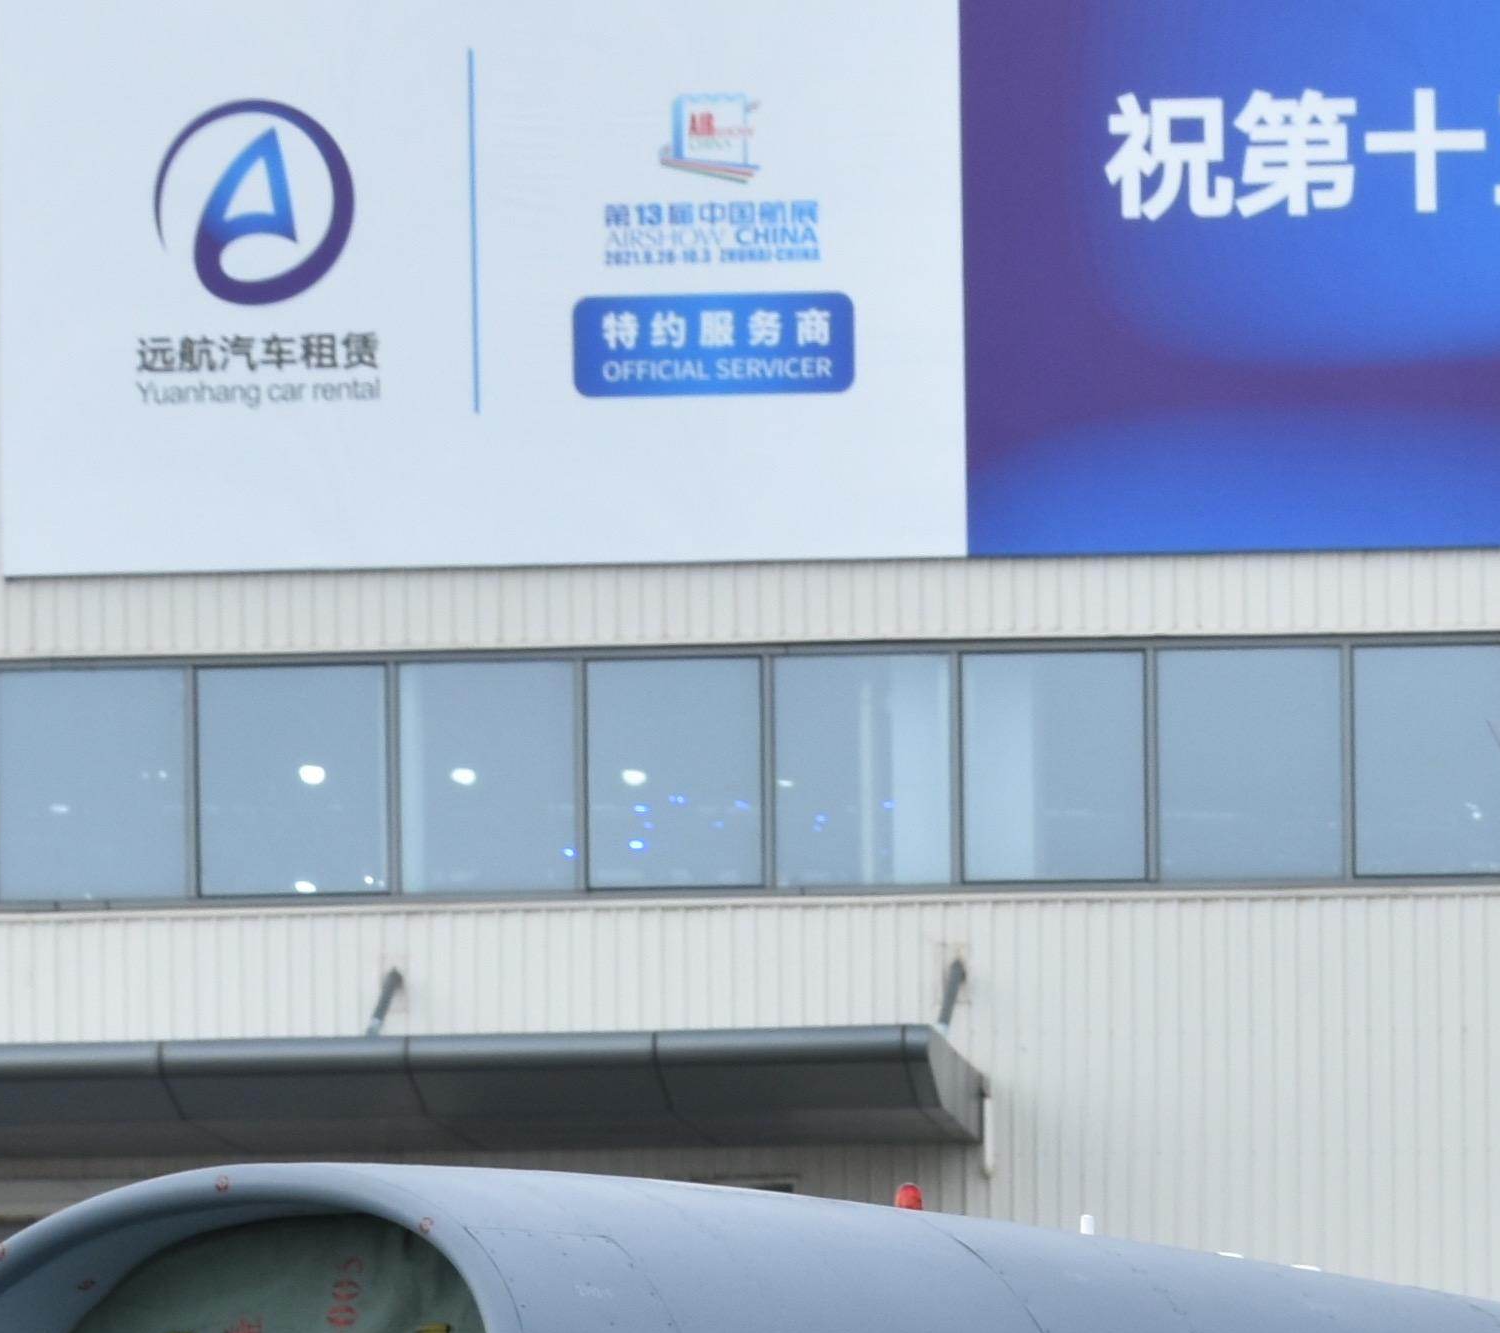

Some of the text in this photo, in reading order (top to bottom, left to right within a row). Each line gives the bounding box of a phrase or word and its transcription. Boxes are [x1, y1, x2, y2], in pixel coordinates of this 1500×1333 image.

[604, 199, 819, 227] 第13届中国航展
[735, 224, 819, 246] CHINA
[602, 307, 832, 350] 特约服务商
[136, 331, 379, 373] 远航汽车租赁
[602, 356, 833, 383] OFFICIAL SERVICER
[136, 376, 381, 409] Yuanhang car rental
